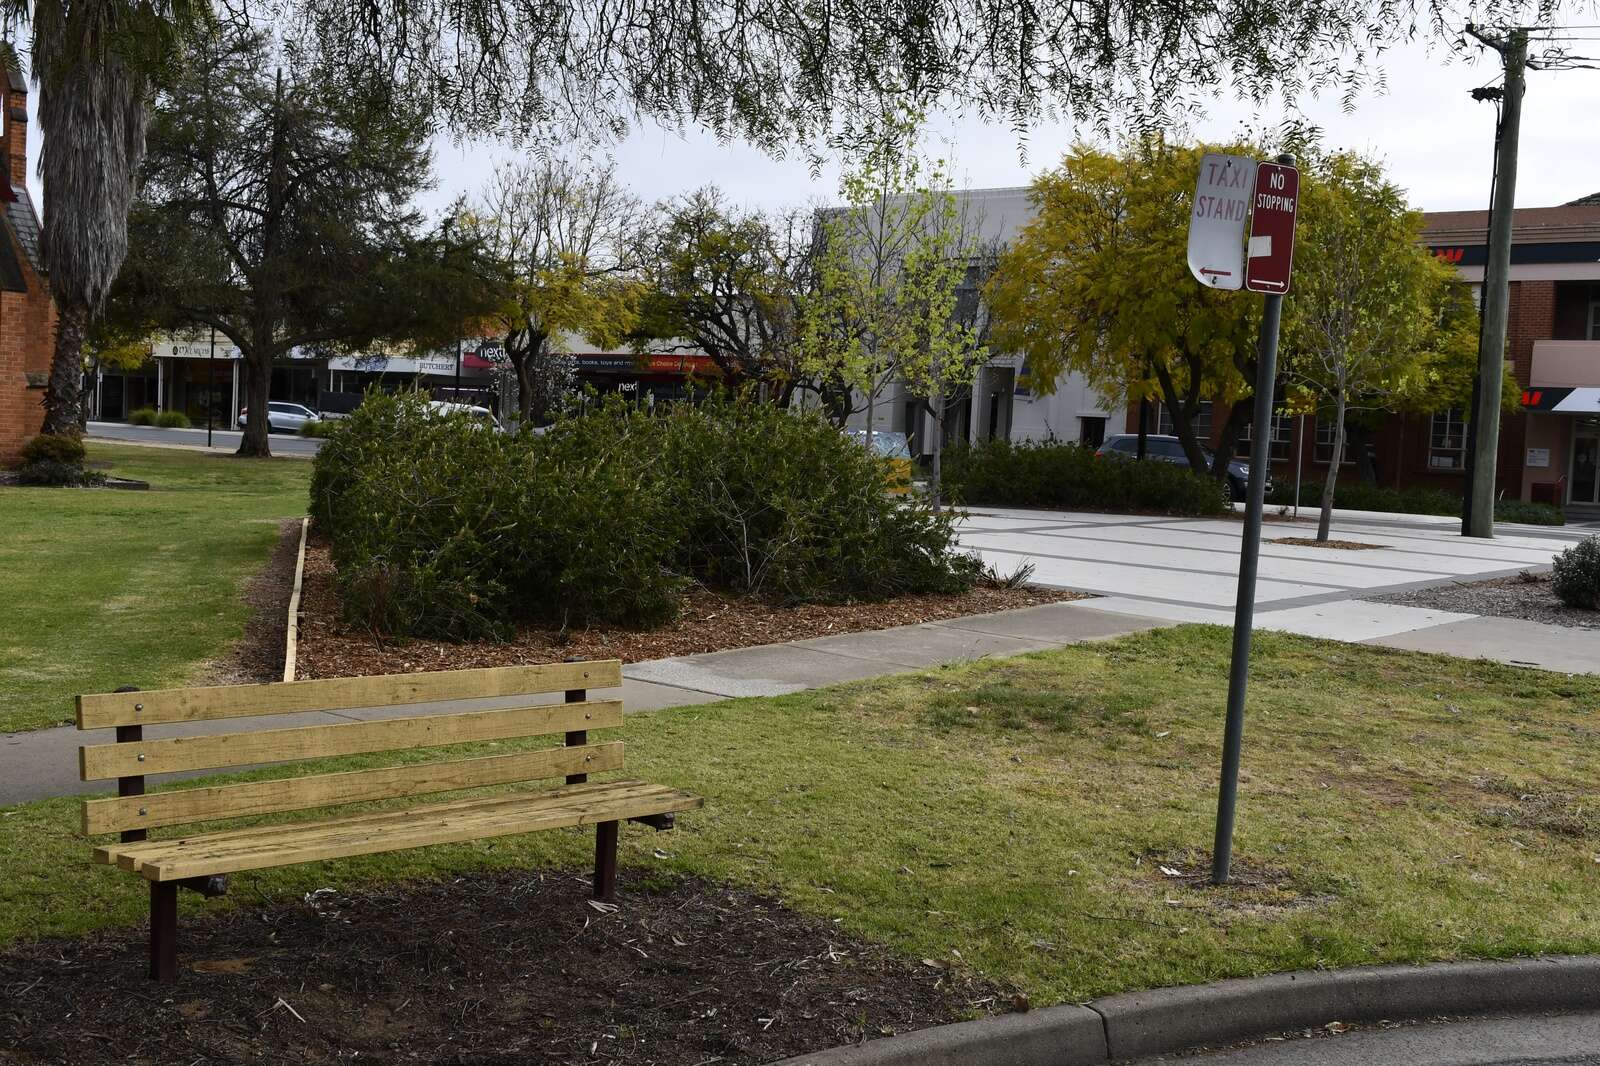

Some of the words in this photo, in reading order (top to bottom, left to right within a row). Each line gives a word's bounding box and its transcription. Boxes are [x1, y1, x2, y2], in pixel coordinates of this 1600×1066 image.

[1208, 163, 1247, 189] TAXI
[1270, 173, 1285, 190] NO
[1197, 196, 1246, 221] STAND
[1257, 193, 1294, 213] STOPPING
[419, 361, 455, 371] BUTCHERY
